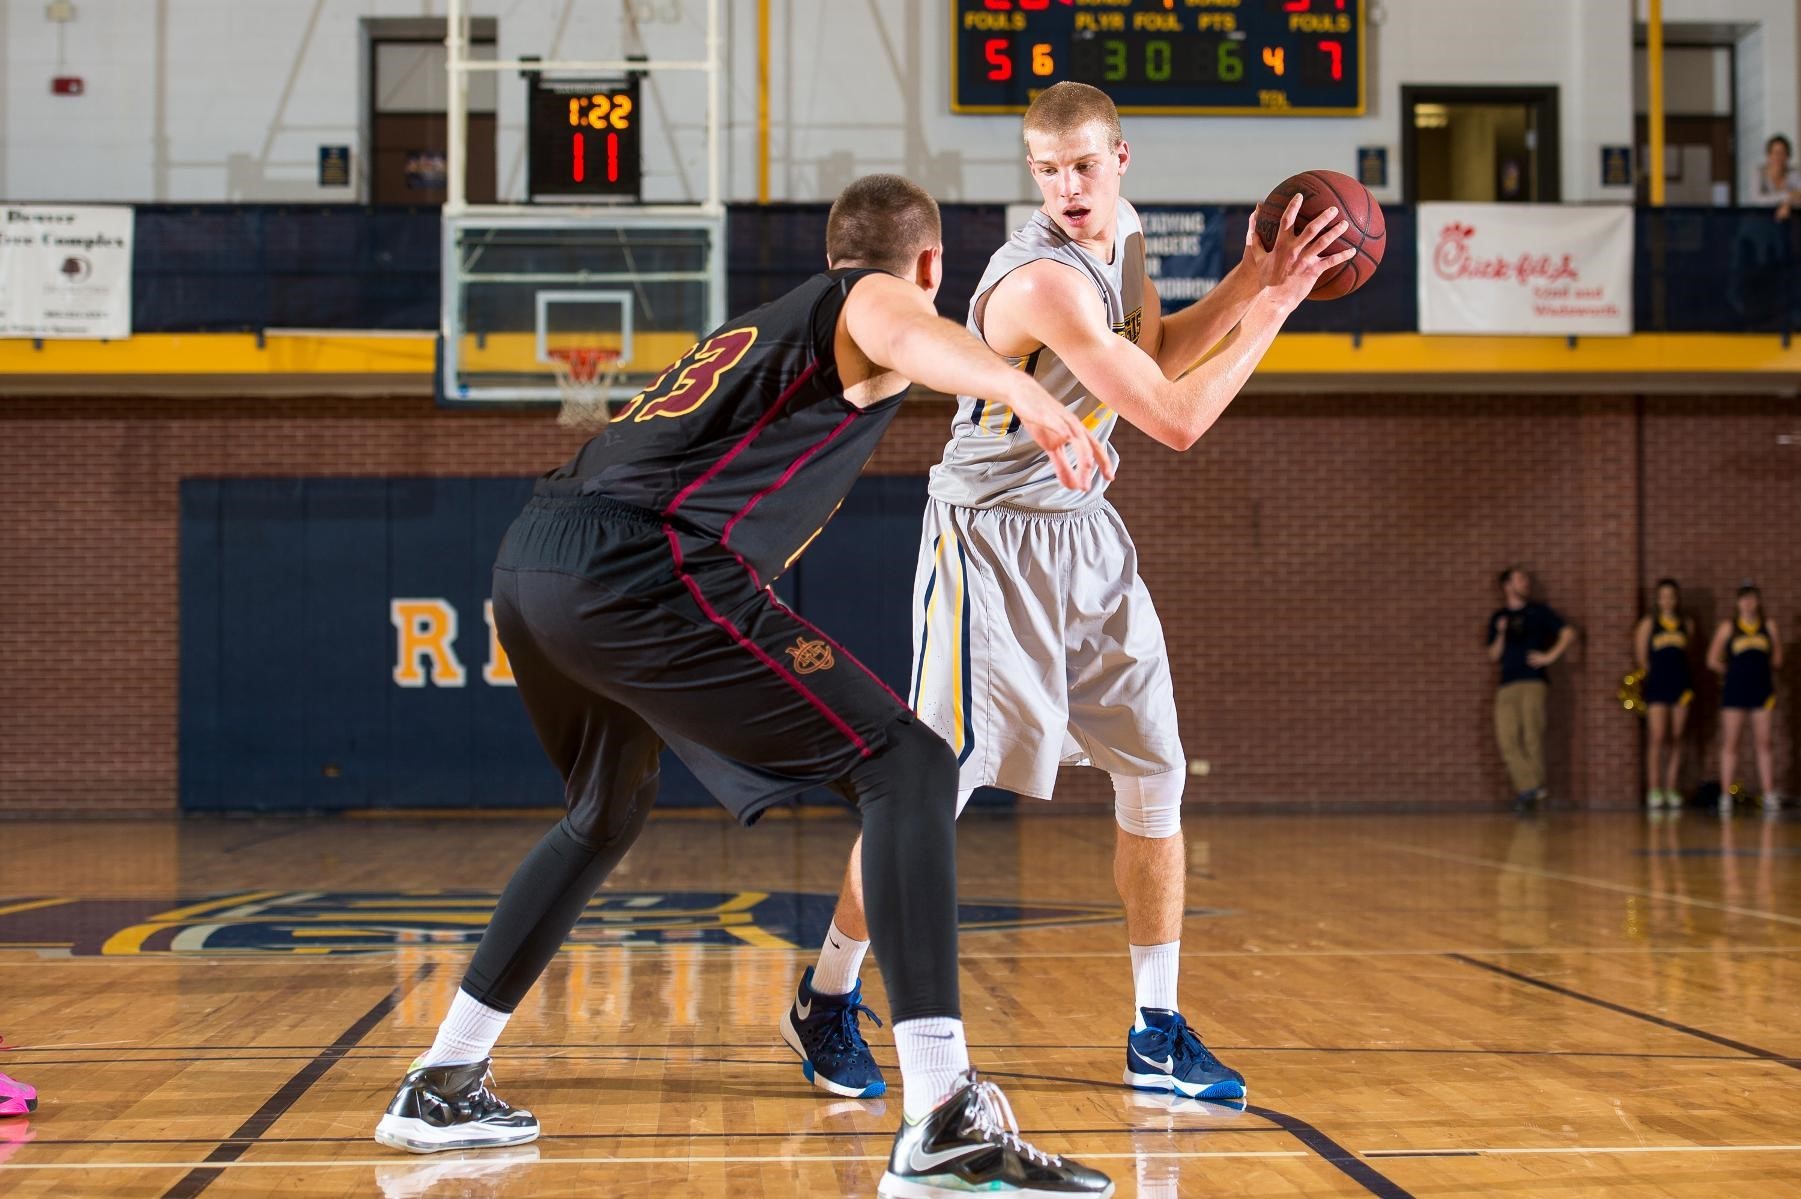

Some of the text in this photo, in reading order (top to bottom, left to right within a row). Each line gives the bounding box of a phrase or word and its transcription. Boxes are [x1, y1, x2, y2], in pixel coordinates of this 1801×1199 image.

[964, 12, 1027, 30] FOULS
[1075, 12, 1237, 31] PLYR FOUL PTS
[1288, 13, 1352, 32] FOULS
[985, 39, 1012, 81] 5
[1032, 43, 1054, 76] 6
[1104, 41, 1128, 81] 3
[1145, 41, 1171, 81] 0
[1217, 40, 1243, 81] 6
[1262, 46, 1285, 76] 4
[1318, 41, 1342, 81] 7
[569, 94, 632, 129] 1:22
[573, 132, 619, 183] 11
